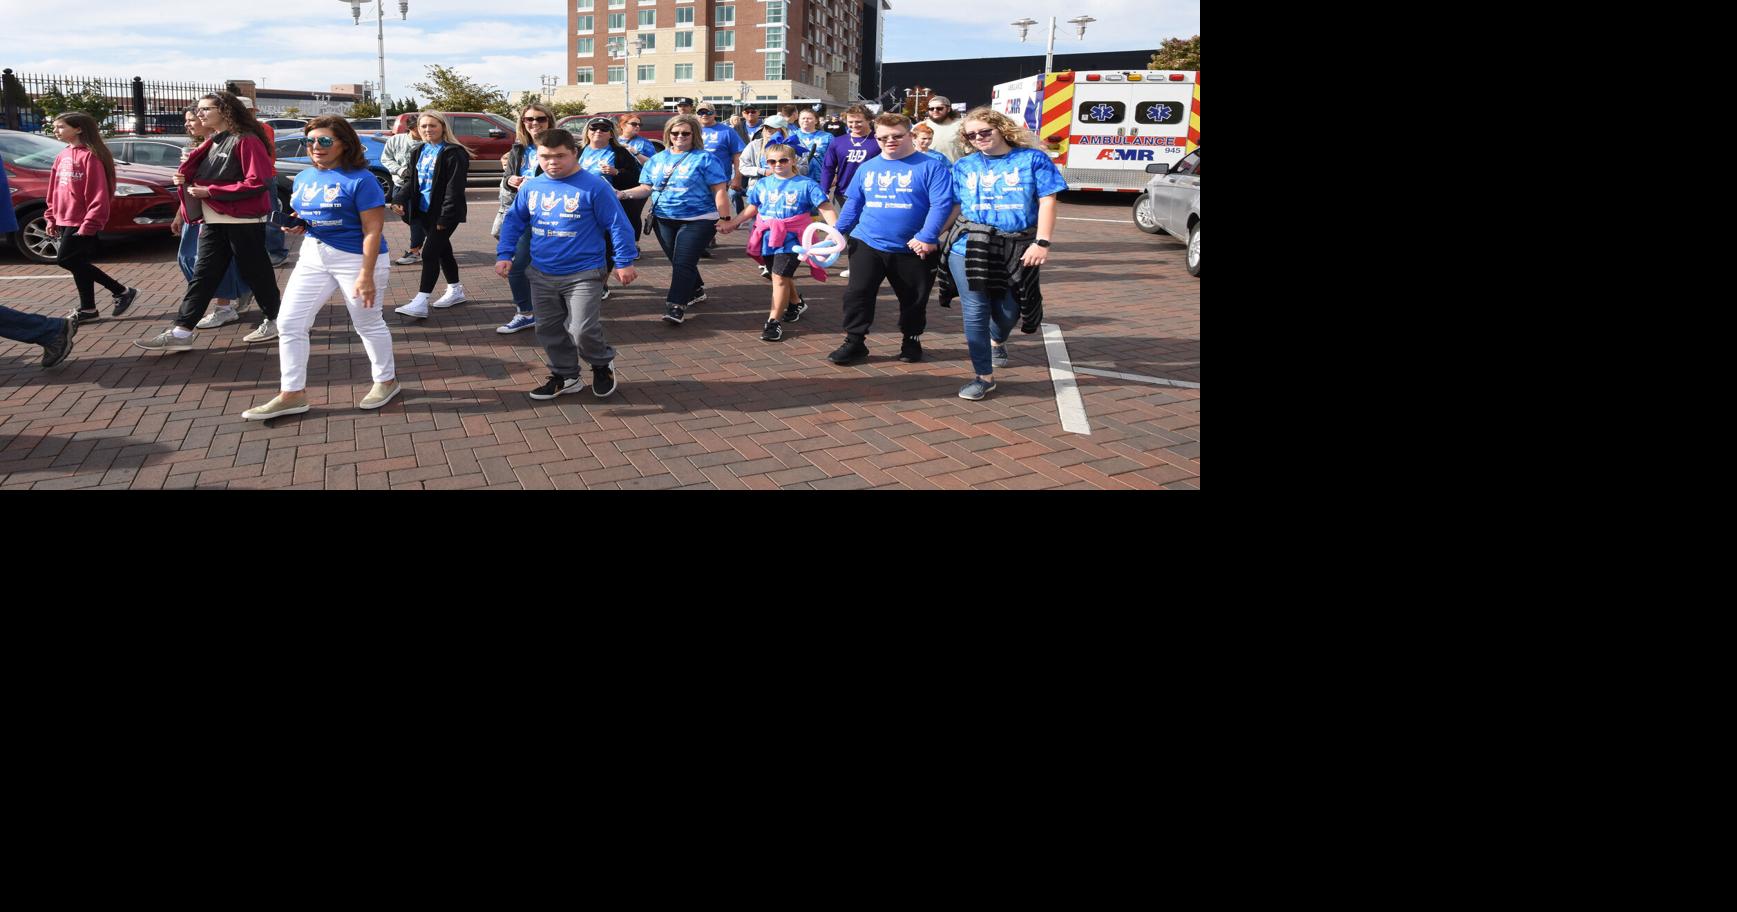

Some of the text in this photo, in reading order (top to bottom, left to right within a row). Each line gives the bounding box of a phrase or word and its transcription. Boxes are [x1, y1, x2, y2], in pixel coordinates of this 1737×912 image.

[1005, 98, 1021, 114] AMR
[1079, 135, 1176, 146] AMBULANCE
[1096, 149, 1155, 161] AMR
